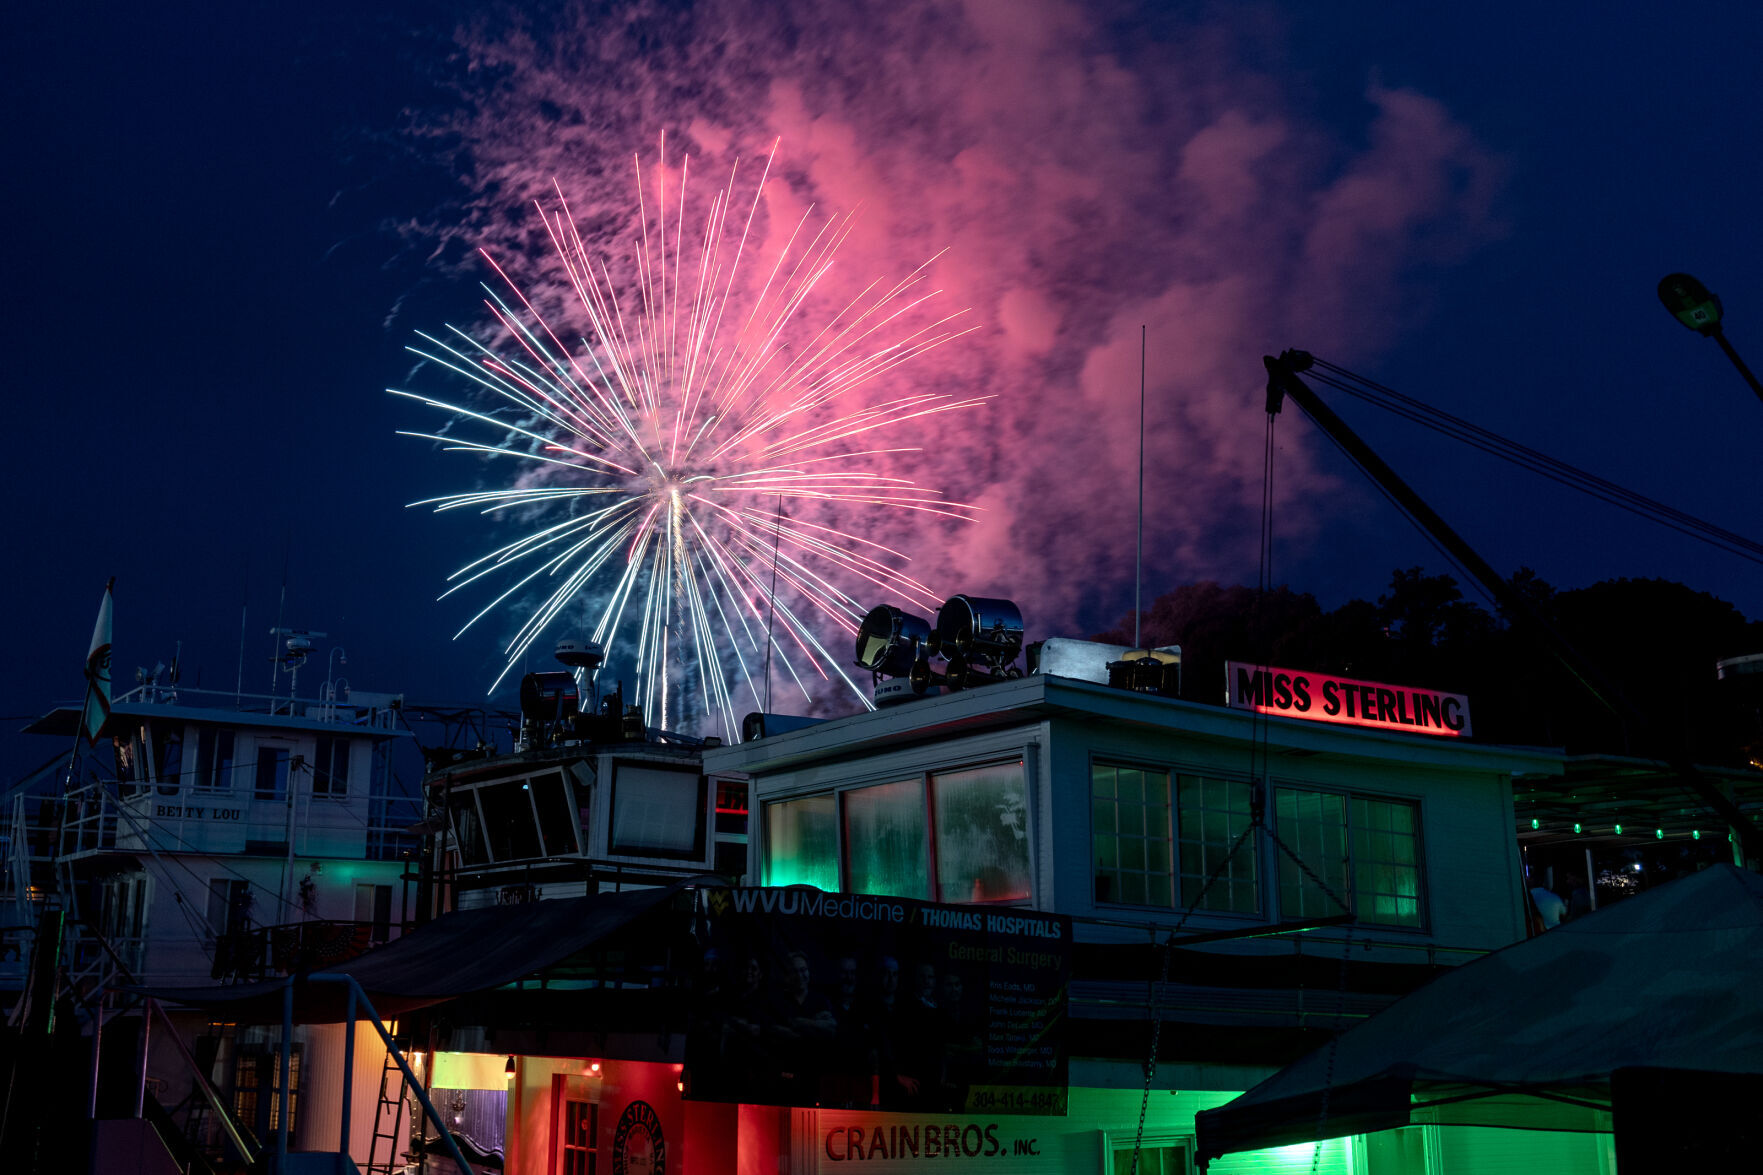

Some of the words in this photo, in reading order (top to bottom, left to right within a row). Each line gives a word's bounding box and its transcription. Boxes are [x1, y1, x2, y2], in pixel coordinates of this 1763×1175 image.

[1237, 668, 1311, 712] MISS
[1322, 680, 1464, 731] STERLING
[157, 805, 205, 819] BETTY
[213, 808, 240, 820] LOU
[921, 907, 982, 932] THOMAS
[986, 914, 1062, 939] HOSPITALS
[948, 941, 1003, 963] General
[1008, 945, 1062, 970] Surgery
[826, 1125, 920, 1161] CRAIN
[924, 1123, 1007, 1158] BROS.
[1014, 1138, 1041, 1157] INC.
